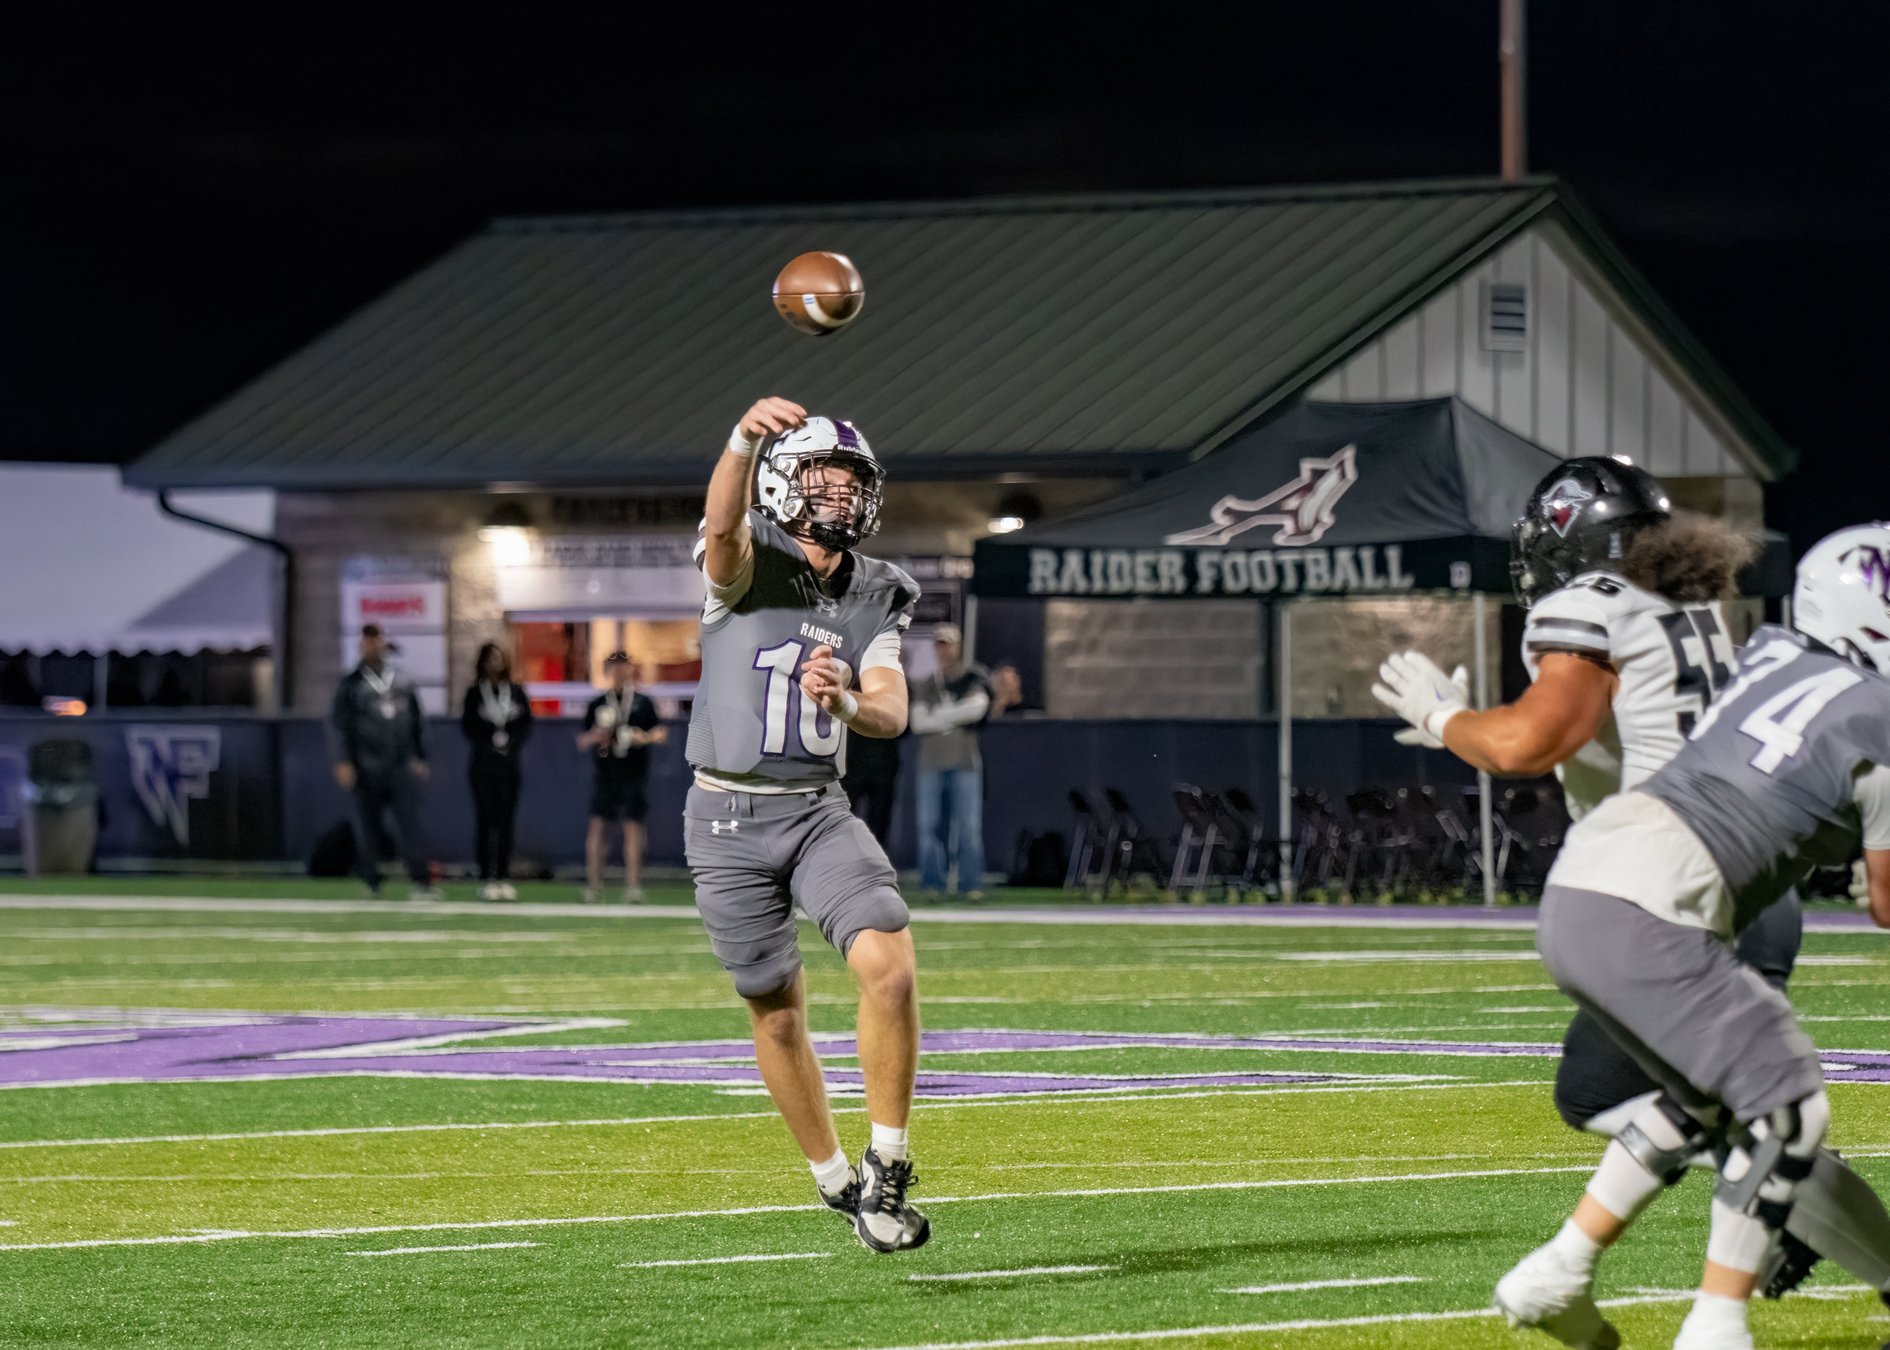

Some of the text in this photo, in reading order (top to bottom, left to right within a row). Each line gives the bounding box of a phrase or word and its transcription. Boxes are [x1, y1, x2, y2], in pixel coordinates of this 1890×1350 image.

[1029, 548, 1186, 594] RAIDER
[1196, 545, 1415, 593] FOOTBALL
[801, 622, 843, 648] RAIDERS
[1688, 639, 1865, 774] 74
